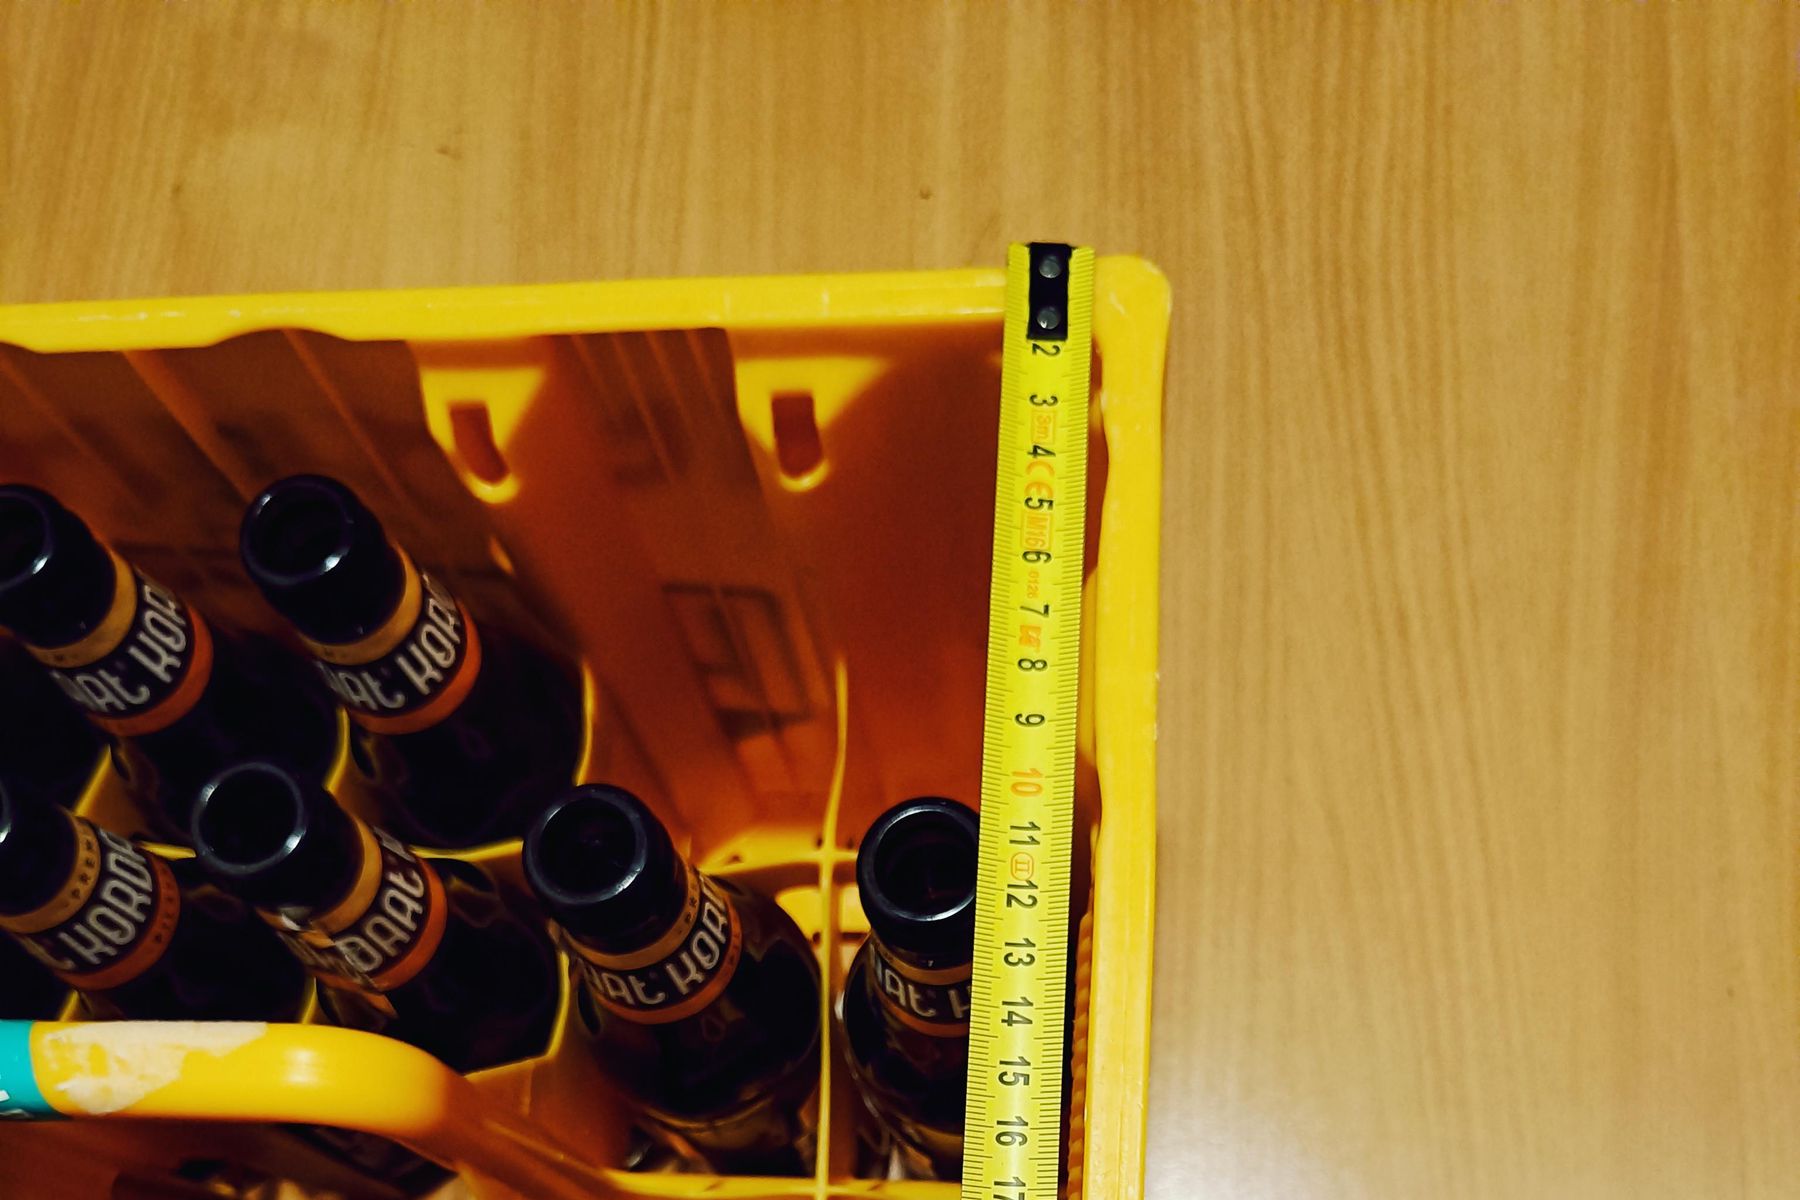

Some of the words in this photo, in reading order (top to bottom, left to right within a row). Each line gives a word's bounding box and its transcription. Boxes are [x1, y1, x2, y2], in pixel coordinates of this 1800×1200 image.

[1032, 342, 1061, 357] 2
[1029, 394, 1058, 407] 3
[1027, 445, 1056, 459] 4
[1024, 497, 1054, 511] 5
[1021, 550, 1052, 564] 6
[1019, 603, 1050, 618] 7
[1017, 658, 1048, 672] 8
[1015, 713, 1046, 727] 9
[1010, 767, 1044, 798] 10
[1008, 821, 1041, 846] 11
[1006, 880, 1038, 909] 12
[1003, 937, 1036, 968] 13
[1000, 996, 1034, 1027] 14
[997, 1055, 1031, 1087] 15
[995, 1115, 1029, 1147] 16
